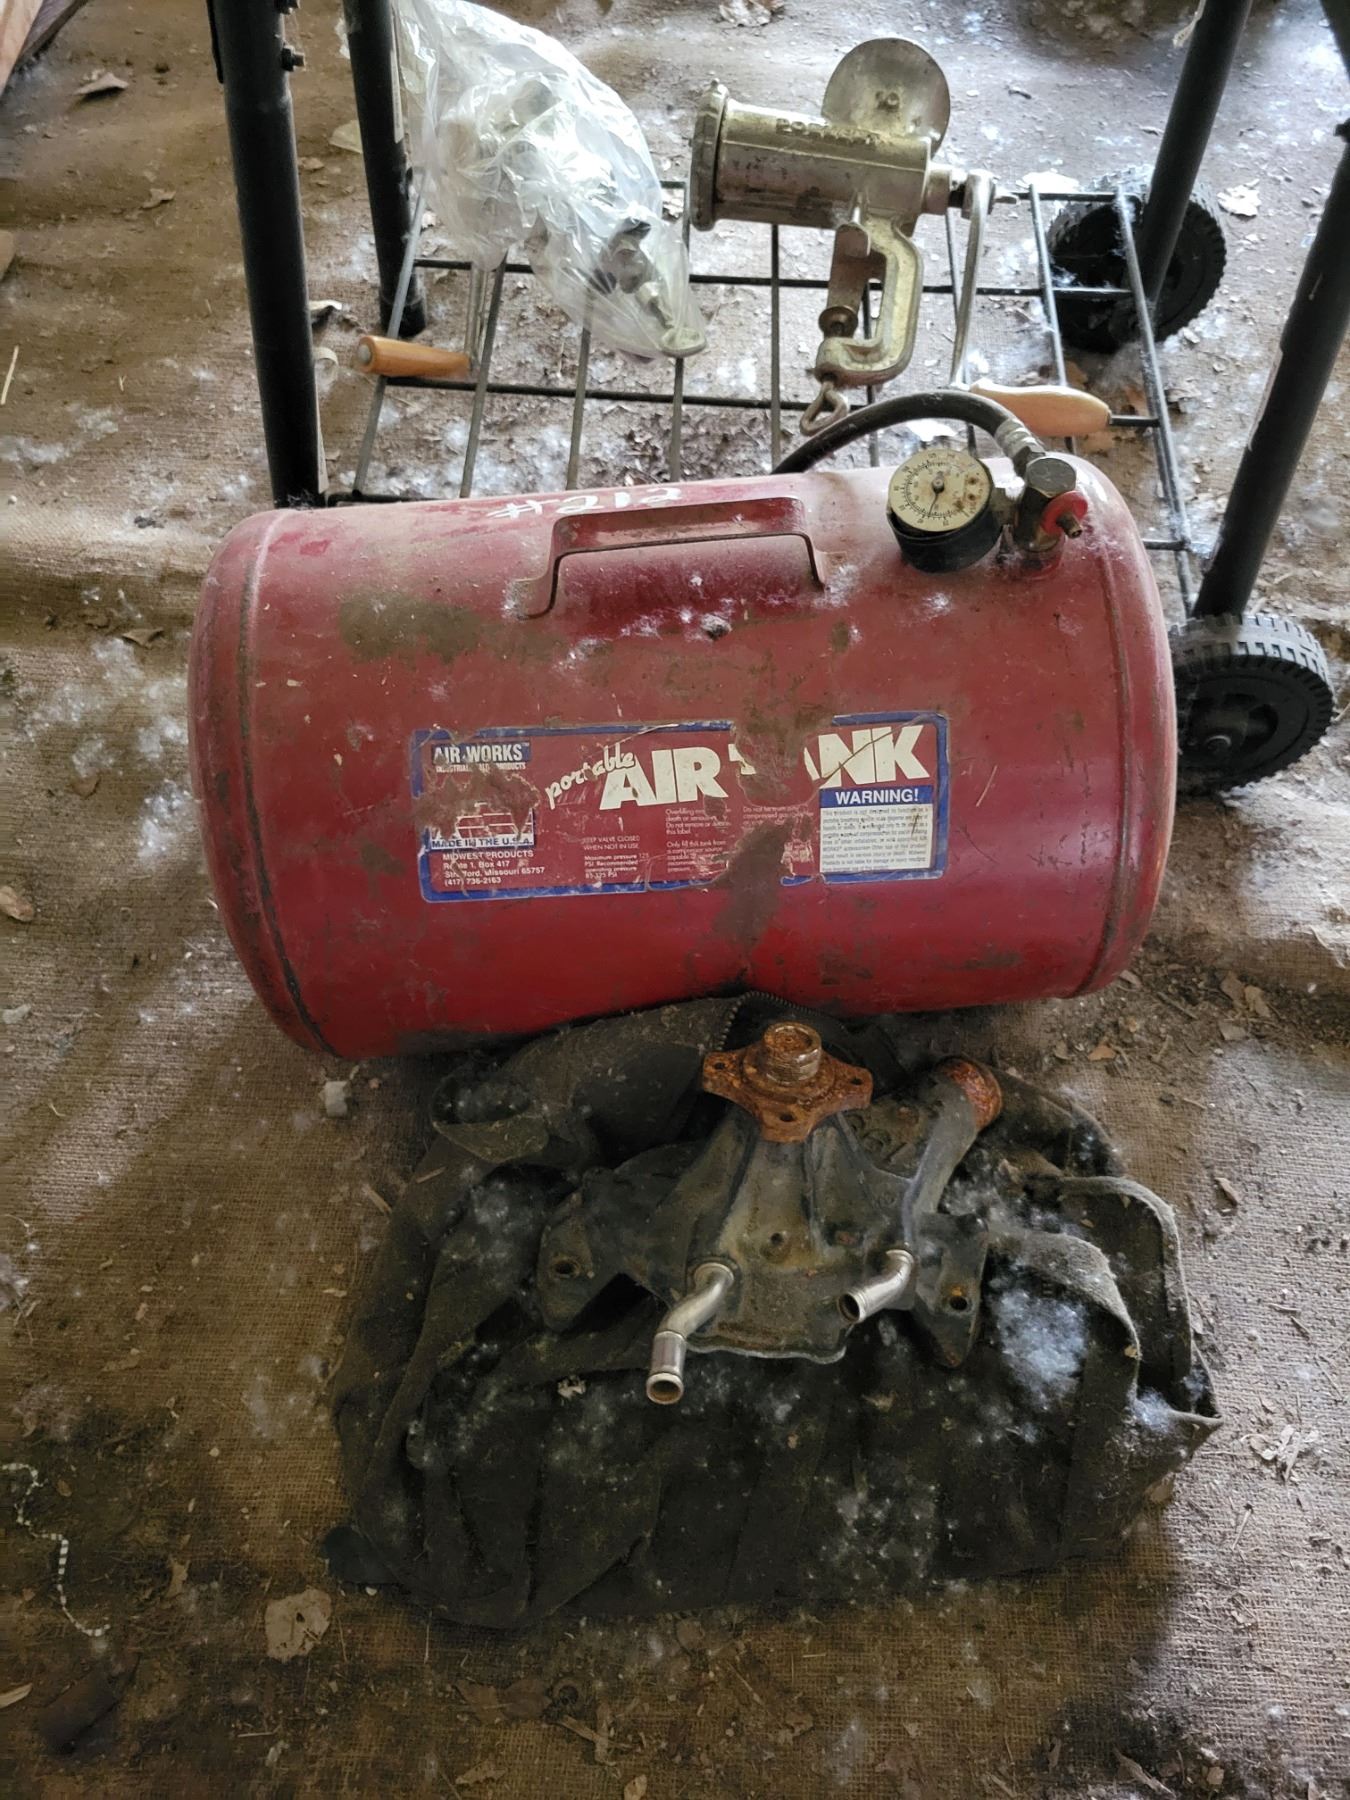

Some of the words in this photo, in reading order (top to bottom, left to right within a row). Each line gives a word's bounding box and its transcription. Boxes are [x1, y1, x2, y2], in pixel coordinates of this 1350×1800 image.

[486, 487, 683, 519] #212
[433, 746, 461, 764] AIR
[545, 742, 636, 810] portable
[598, 747, 730, 811] AIR
[835, 788, 919, 805] WARNING!
[432, 839, 463, 848] MADE
[479, 837, 501, 847] THE
[442, 852, 483, 861] MIDWEST
[486, 850, 534, 859] PRODUCTS
[479, 860, 494, 869] Box
[496, 860, 510, 868] 417
[485, 868, 520, 876] Missouri
[521, 866, 545, 875] 65757
[444, 878, 463, 887] (417)
